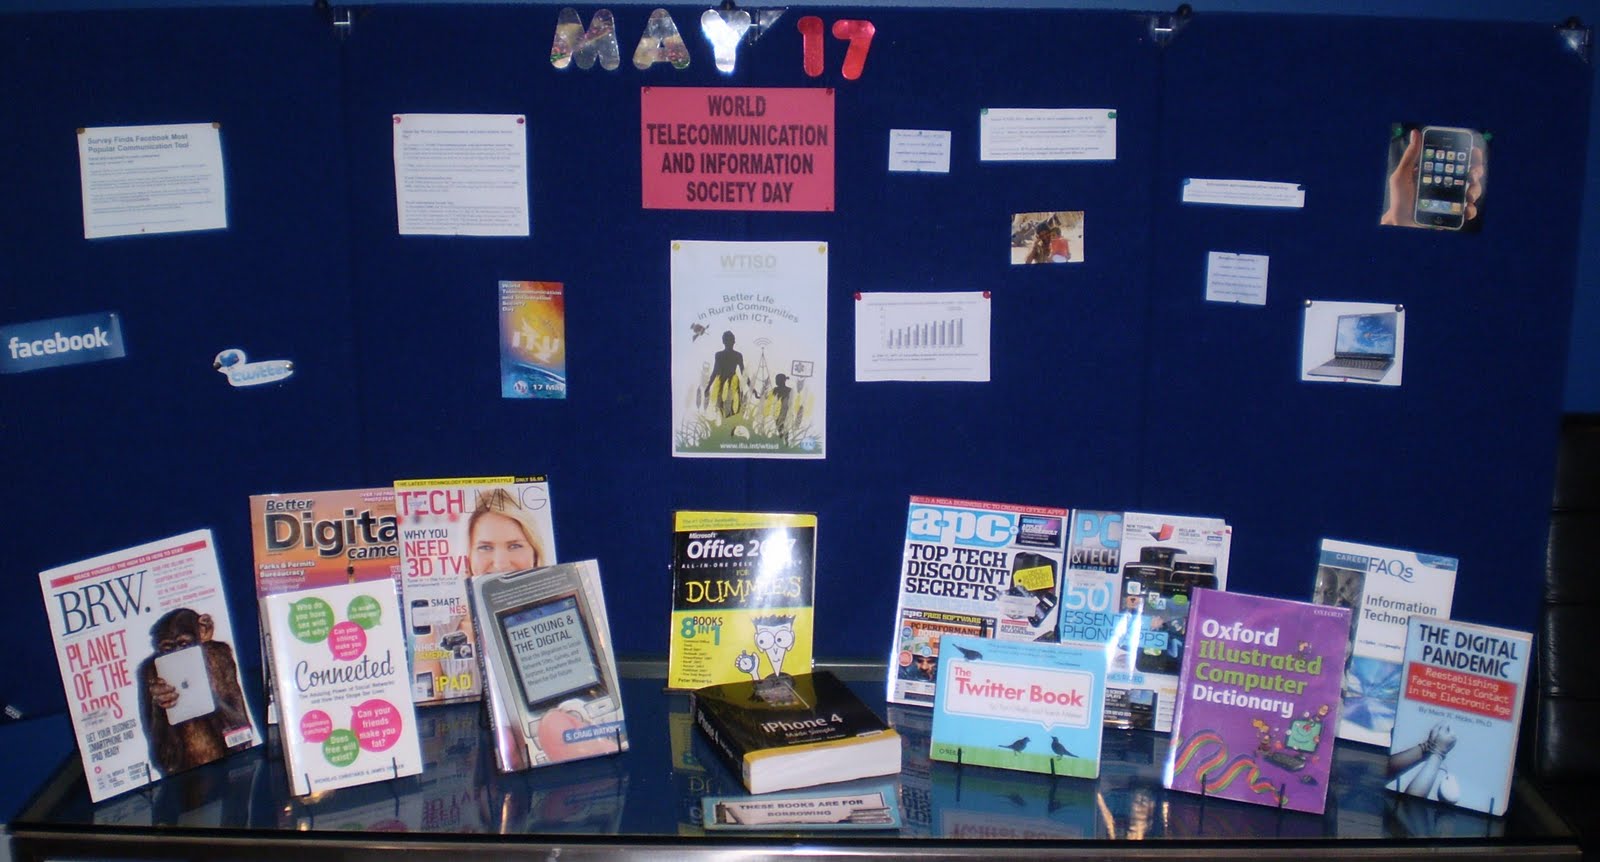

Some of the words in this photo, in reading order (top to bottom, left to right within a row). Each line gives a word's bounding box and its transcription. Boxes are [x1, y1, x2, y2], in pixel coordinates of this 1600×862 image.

[551, 8, 751, 72] MAY
[797, 16, 875, 80] 17
[708, 95, 766, 117] WORLD
[647, 124, 828, 146] TELECOMMUNICATION
[88, 146, 115, 154] Popular
[118, 143, 172, 151] Communication
[662, 153, 694, 173] AND
[701, 154, 813, 174] INFORMATION
[687, 182, 755, 202] SOCIETY
[762, 183, 793, 203] DAY
[720, 255, 776, 268] WTISD
[723, 293, 753, 303] Better
[757, 294, 774, 304] Life
[698, 312, 707, 320] in
[708, 304, 734, 315] Rural
[737, 303, 799, 322] Communities
[728, 314, 748, 322] with
[751, 314, 772, 324] ICTs
[9, 327, 108, 359] facebook
[265, 499, 314, 511] Better
[265, 508, 398, 557] Digita
[404, 530, 427, 539] WHY
[429, 529, 448, 538] YOU
[910, 508, 1010, 545] apc
[1075, 513, 1122, 549] PC
[347, 546, 399, 559] came
[405, 540, 448, 557] NEED
[687, 540, 744, 559] Office
[747, 539, 796, 557] 27
[910, 544, 948, 561] TOP
[953, 547, 1007, 568] TECH
[260, 569, 304, 578] Bureaucracy
[408, 558, 432, 577] 3D
[437, 555, 469, 575] TV!
[907, 561, 1010, 585] DISCOUNT
[1336, 554, 1367, 563] CAREER
[1368, 557, 1415, 583] FAQs
[686, 577, 803, 603] DUMMIES
[906, 577, 999, 601] SECRETS
[296, 602, 312, 611] Who
[431, 598, 460, 607] SMART
[1366, 595, 1437, 616] Information
[296, 613, 308, 622] you
[312, 618, 326, 626] with
[942, 614, 981, 623] SOFTWARE
[1313, 609, 1343, 618] OXFORD
[1365, 609, 1409, 626] Technol
[511, 629, 530, 641] THE
[531, 617, 564, 634] YOUNG
[566, 614, 574, 625] &
[681, 617, 696, 639] 8
[693, 616, 723, 626] BOOKS
[698, 625, 708, 634] IN
[712, 625, 720, 645] 1
[922, 623, 982, 636] PERFORMANC
[1202, 619, 1279, 647] Oxford
[335, 642, 351, 650] make
[337, 634, 358, 642] siblings
[515, 642, 534, 655] THE
[536, 630, 572, 647] DIGITAL
[1420, 624, 1450, 646] THE
[1455, 632, 1518, 660] DIGITAL
[66, 629, 128, 673] PLANET
[1199, 640, 1322, 675] Illustrated
[295, 650, 394, 692] Connected
[954, 666, 971, 677] The
[1422, 645, 1510, 678] PANDEMIC
[73, 670, 94, 701] OF
[97, 660, 132, 694] THE
[1195, 662, 1308, 695] Computer
[1426, 668, 1499, 692] Reestablishing
[955, 677, 1025, 700] Twitter
[1029, 684, 1084, 707] Book
[1412, 676, 1471, 695] Face-to-Face
[1473, 689, 1509, 704] Contact
[1192, 684, 1295, 718] Dictionary
[1408, 687, 1419, 695] in
[1422, 689, 1437, 699] the
[1441, 692, 1491, 711] Electronic
[1494, 704, 1510, 715] Age
[357, 709, 373, 718] Can
[374, 706, 391, 717] your
[362, 718, 389, 728] friends
[763, 718, 827, 733] iPhone
[831, 713, 843, 723] 4
[785, 730, 805, 739] Made
[807, 726, 836, 736] Simple
[330, 735, 349, 744] Does
[359, 730, 379, 739] make
[381, 728, 396, 737] you
[371, 738, 386, 748] fat?
[565, 731, 572, 740] S.
[574, 729, 592, 739] CRAIG
[325, 744, 341, 752] free
[342, 742, 357, 751] will
[331, 752, 353, 762] exist?
